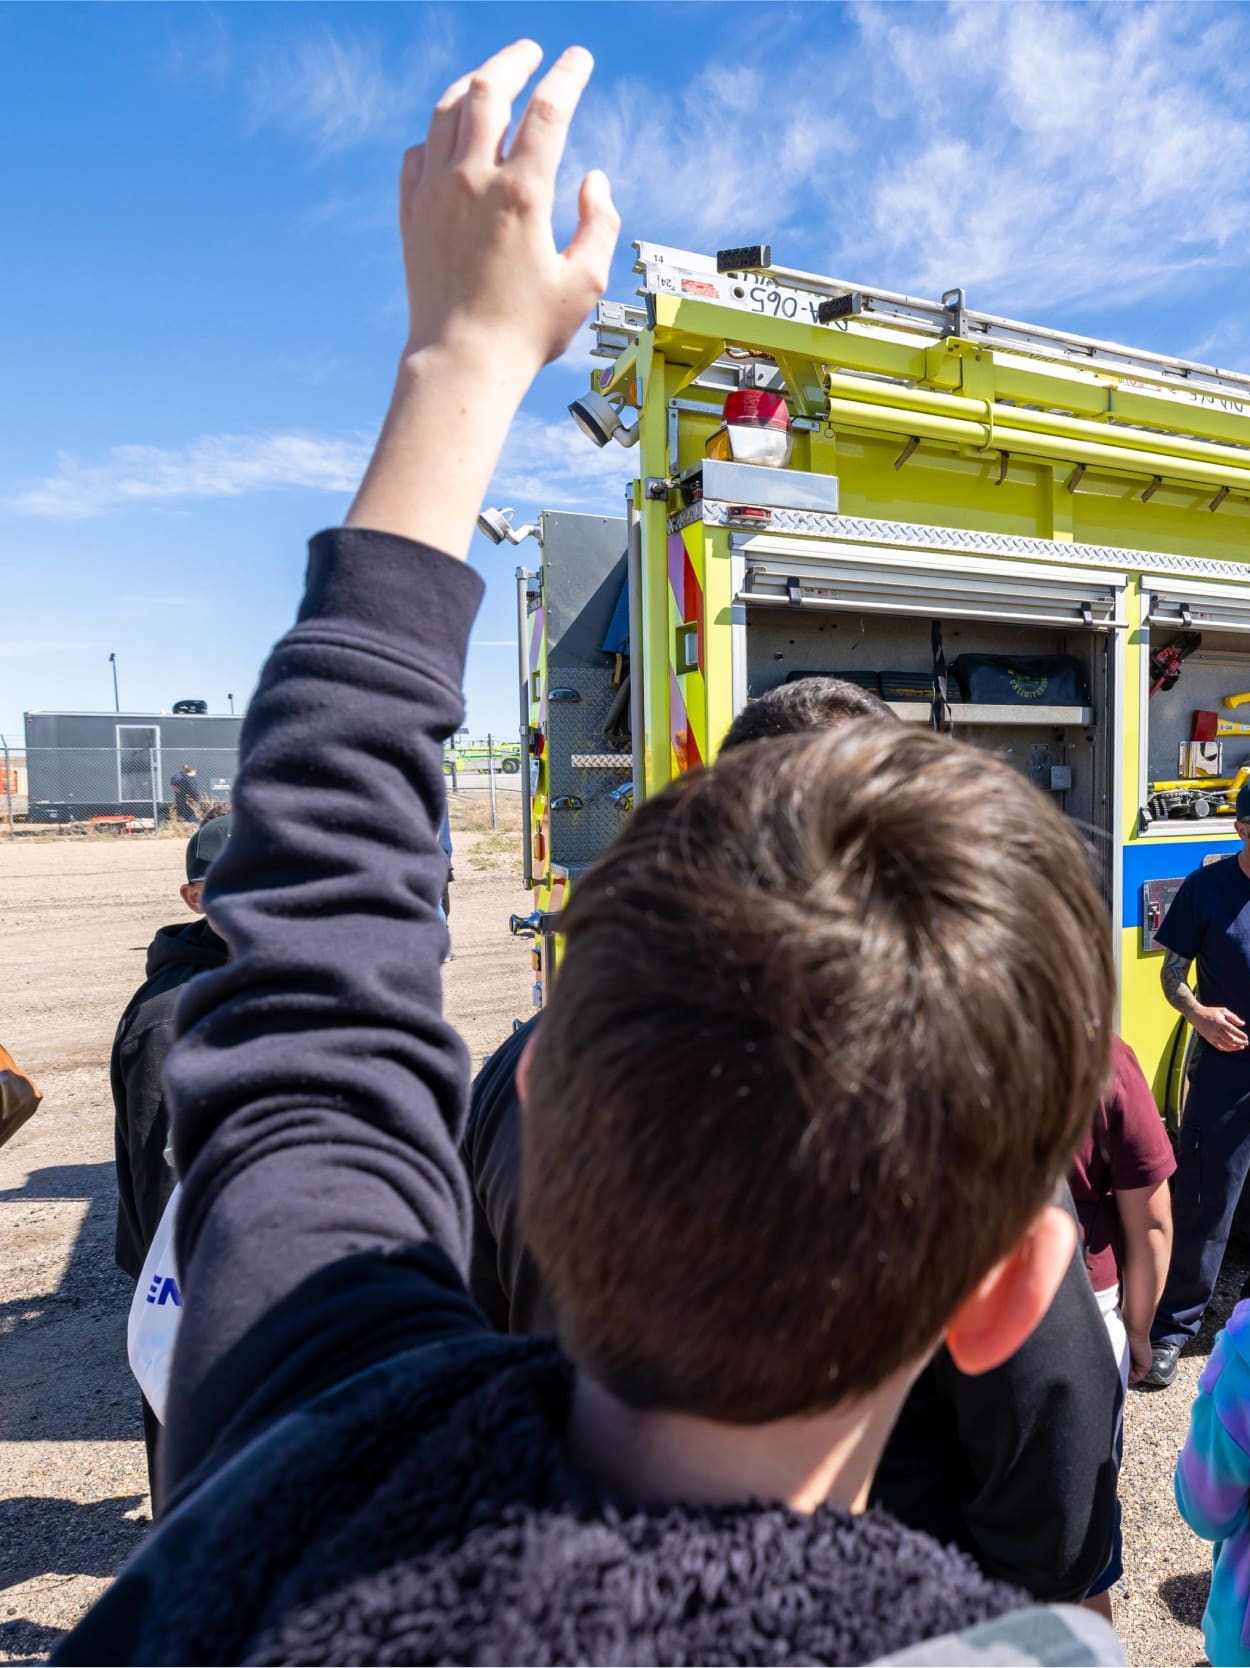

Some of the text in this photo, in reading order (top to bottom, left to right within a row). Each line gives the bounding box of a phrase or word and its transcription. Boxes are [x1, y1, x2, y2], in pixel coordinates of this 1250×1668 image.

[654, 254, 664, 263] 14
[661, 277, 673, 288] 24
[749, 287, 848, 332] DA-065
